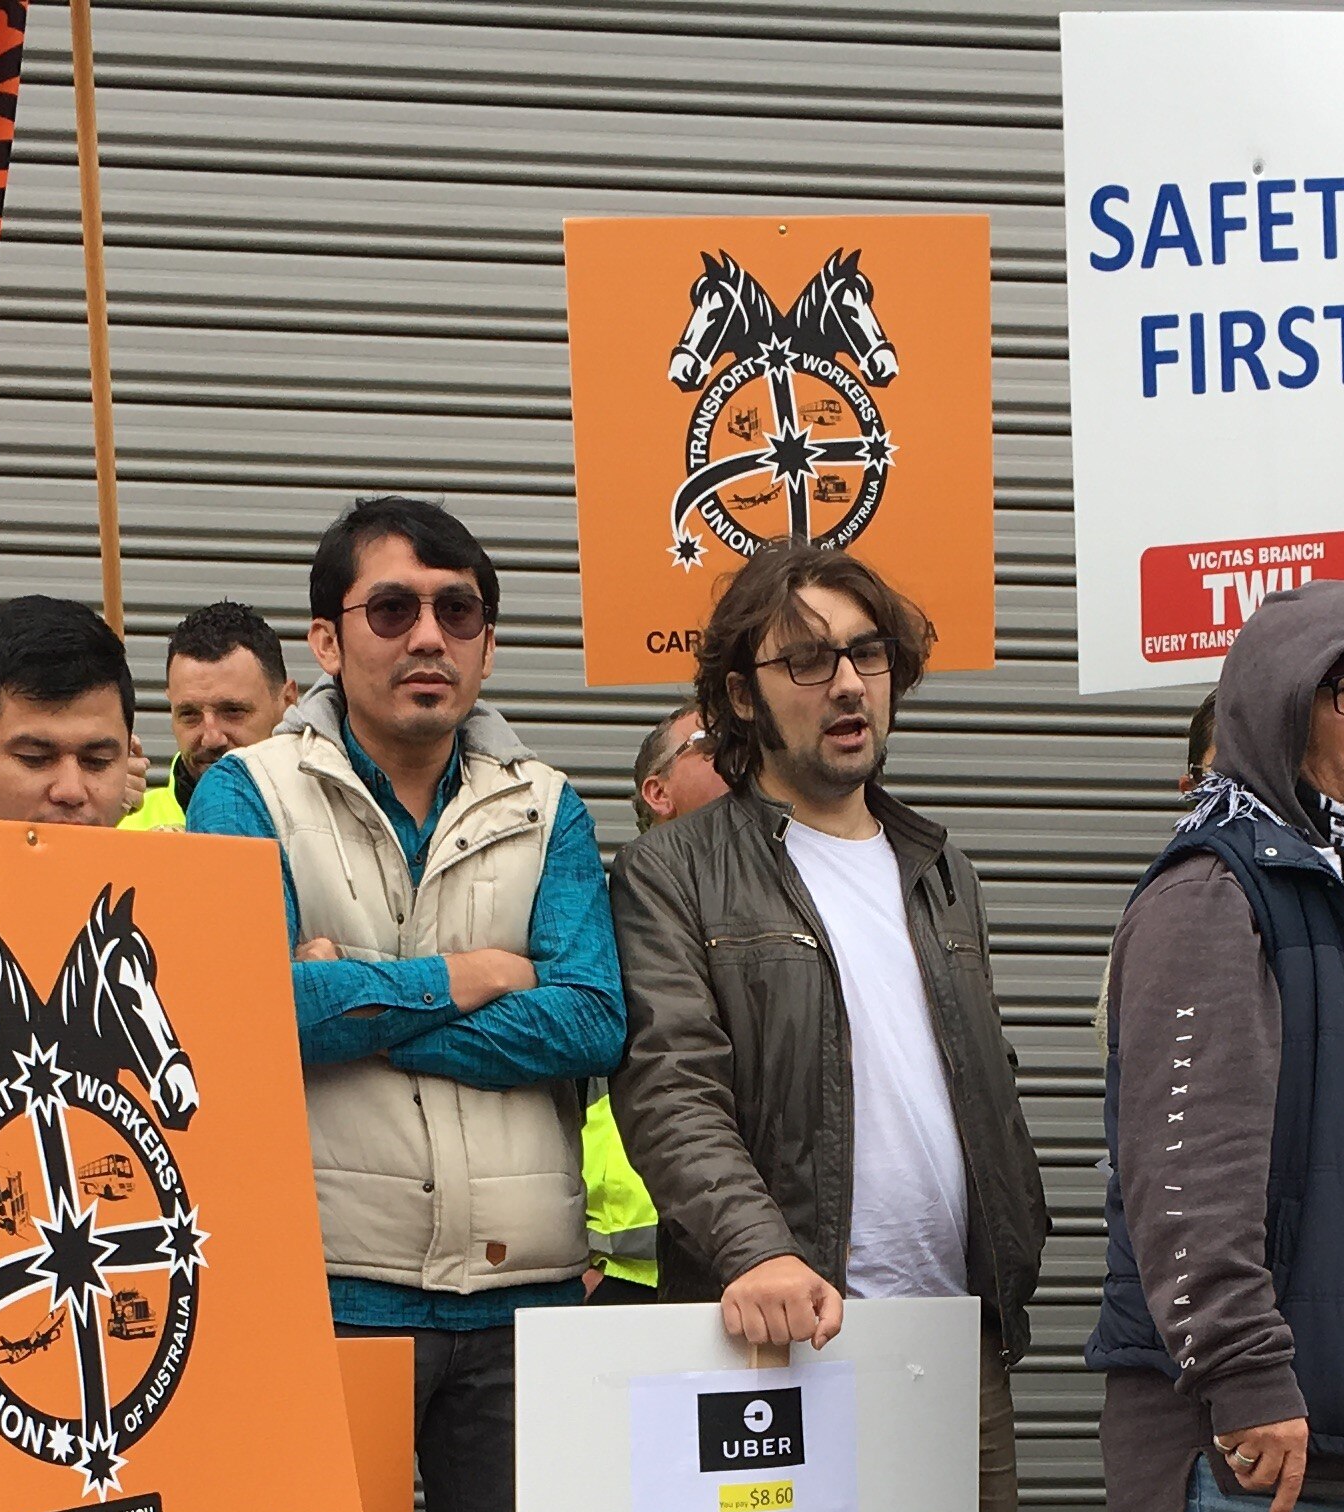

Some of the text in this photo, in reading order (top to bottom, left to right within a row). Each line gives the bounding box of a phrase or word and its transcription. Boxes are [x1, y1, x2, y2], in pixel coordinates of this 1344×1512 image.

[690, 354, 880, 470] TRANSPORT WORKERS'
[700, 499, 761, 556] UNION
[836, 480, 881, 546] AUSTRALIA
[1189, 542, 1325, 570] VIC/TAS BRANCH
[1144, 629, 1240, 654] EVERY TRANS
[77, 1070, 183, 1195] WORKERS'
[124, 1407, 144, 1433] OF
[141, 1294, 191, 1414] AUSTRALIA
[722, 1436, 792, 1459] UBER
[750, 1487, 793, 1509] $8.60
